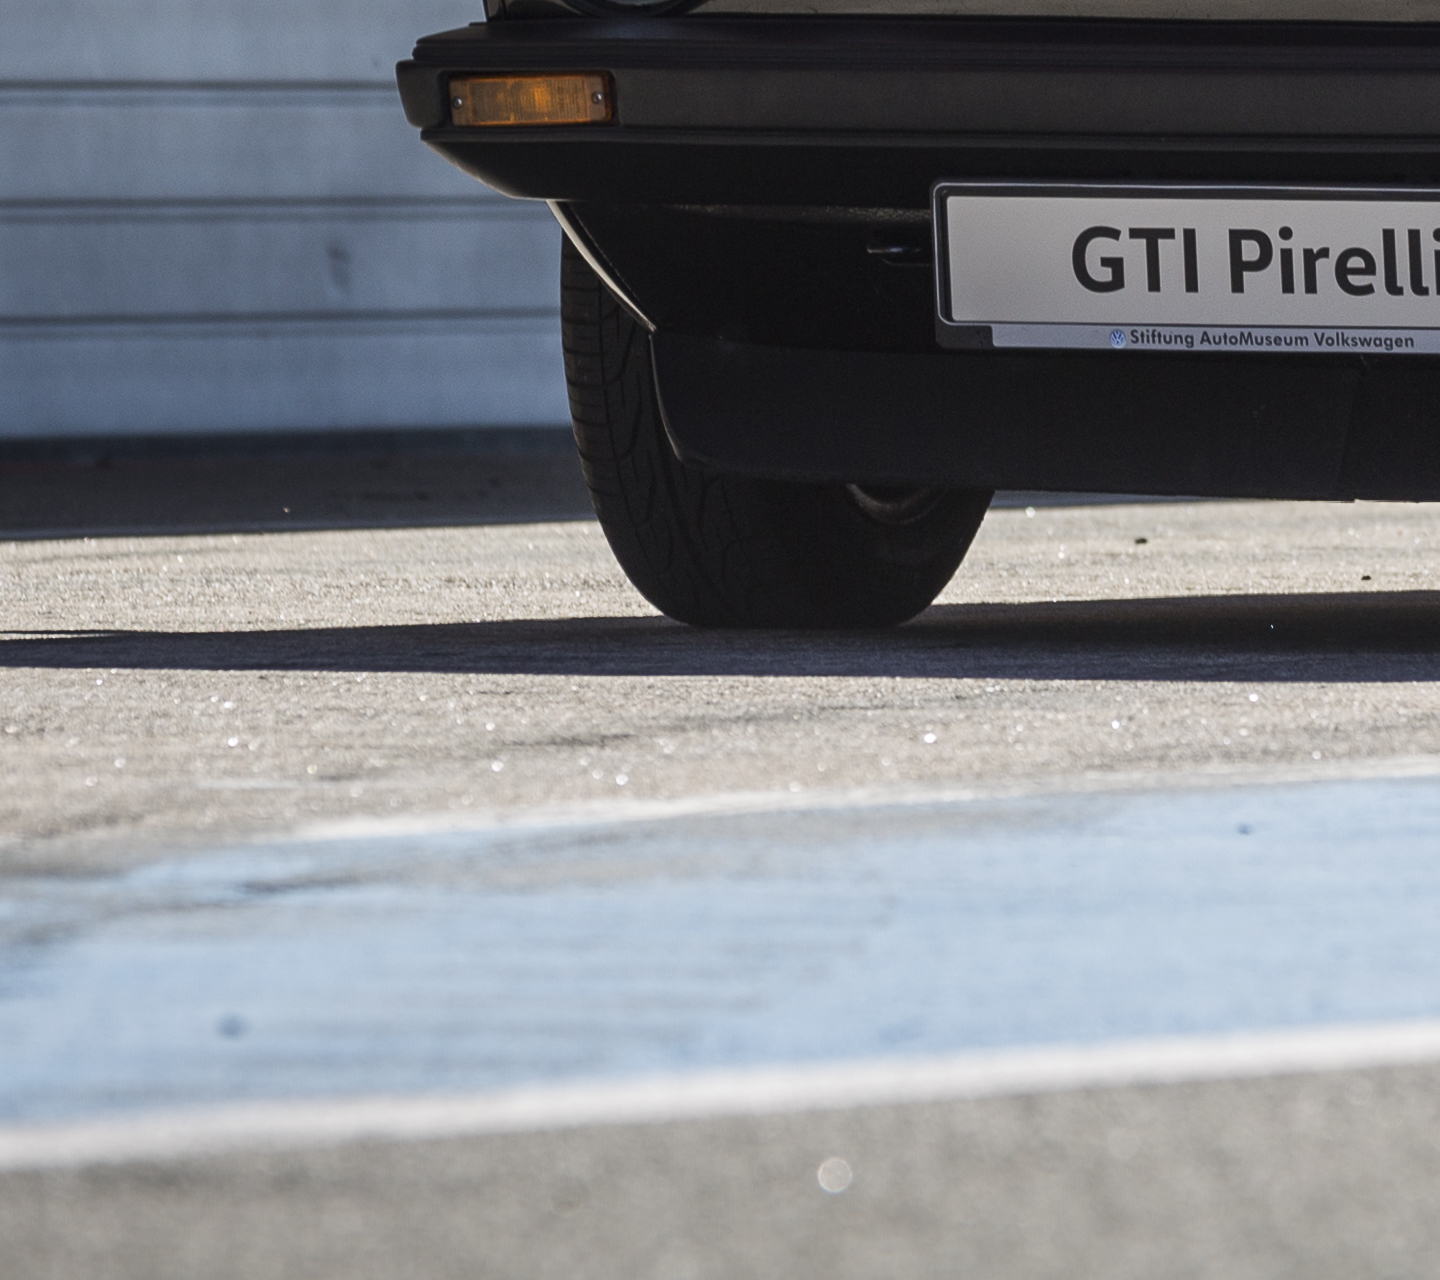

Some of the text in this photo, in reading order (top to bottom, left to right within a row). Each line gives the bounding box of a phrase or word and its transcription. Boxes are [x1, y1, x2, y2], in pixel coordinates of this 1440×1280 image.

[1071, 225, 1199, 294] GTI
[1130, 329, 1195, 348] Stiftung
[1199, 330, 1309, 347] AutoMuseum
[1314, 332, 1415, 349] Volkswagen
